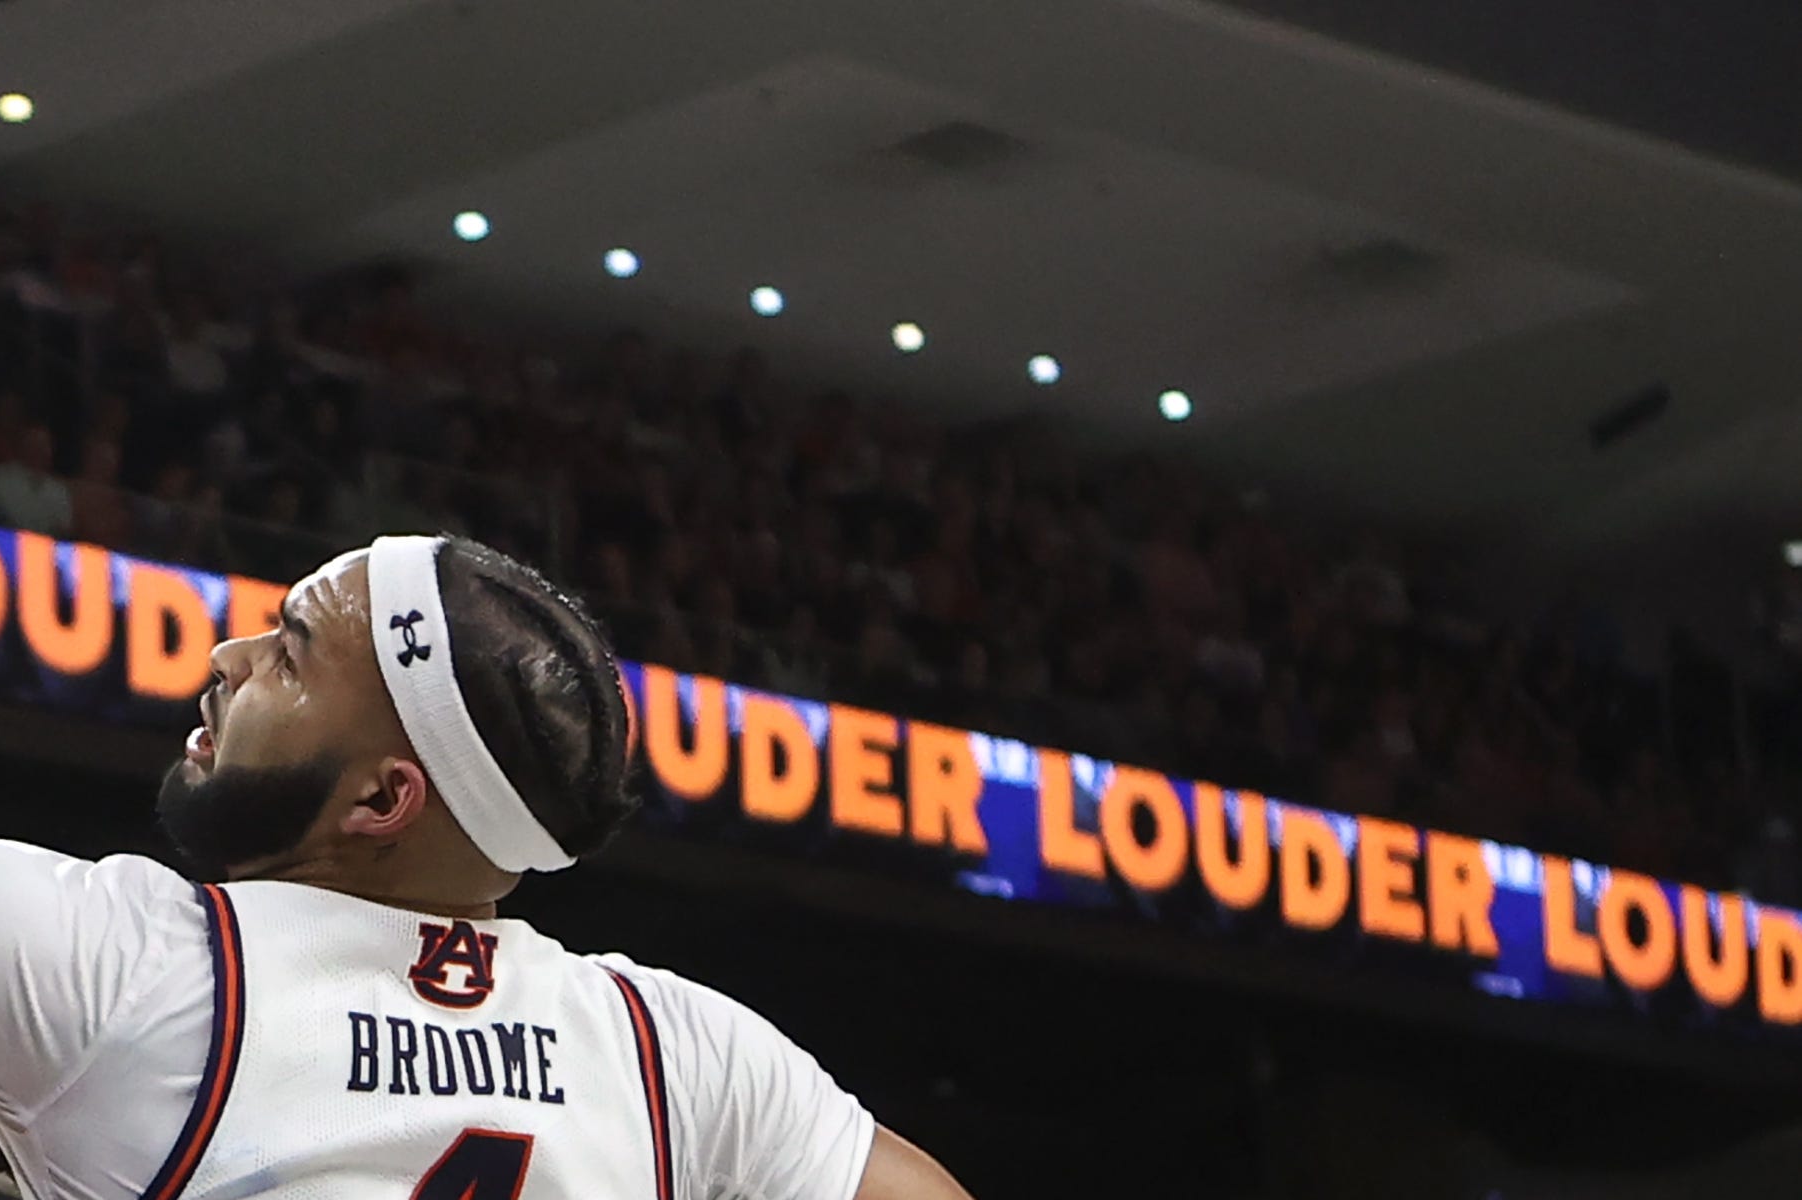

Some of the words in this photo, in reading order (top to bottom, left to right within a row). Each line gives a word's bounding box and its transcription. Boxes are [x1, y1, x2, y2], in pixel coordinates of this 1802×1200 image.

[626, 664, 988, 856] UDER
[1036, 747, 1500, 957] LOUDER
[1541, 854, 1802, 1026] LOUD
[347, 1011, 565, 1104] BROOME
